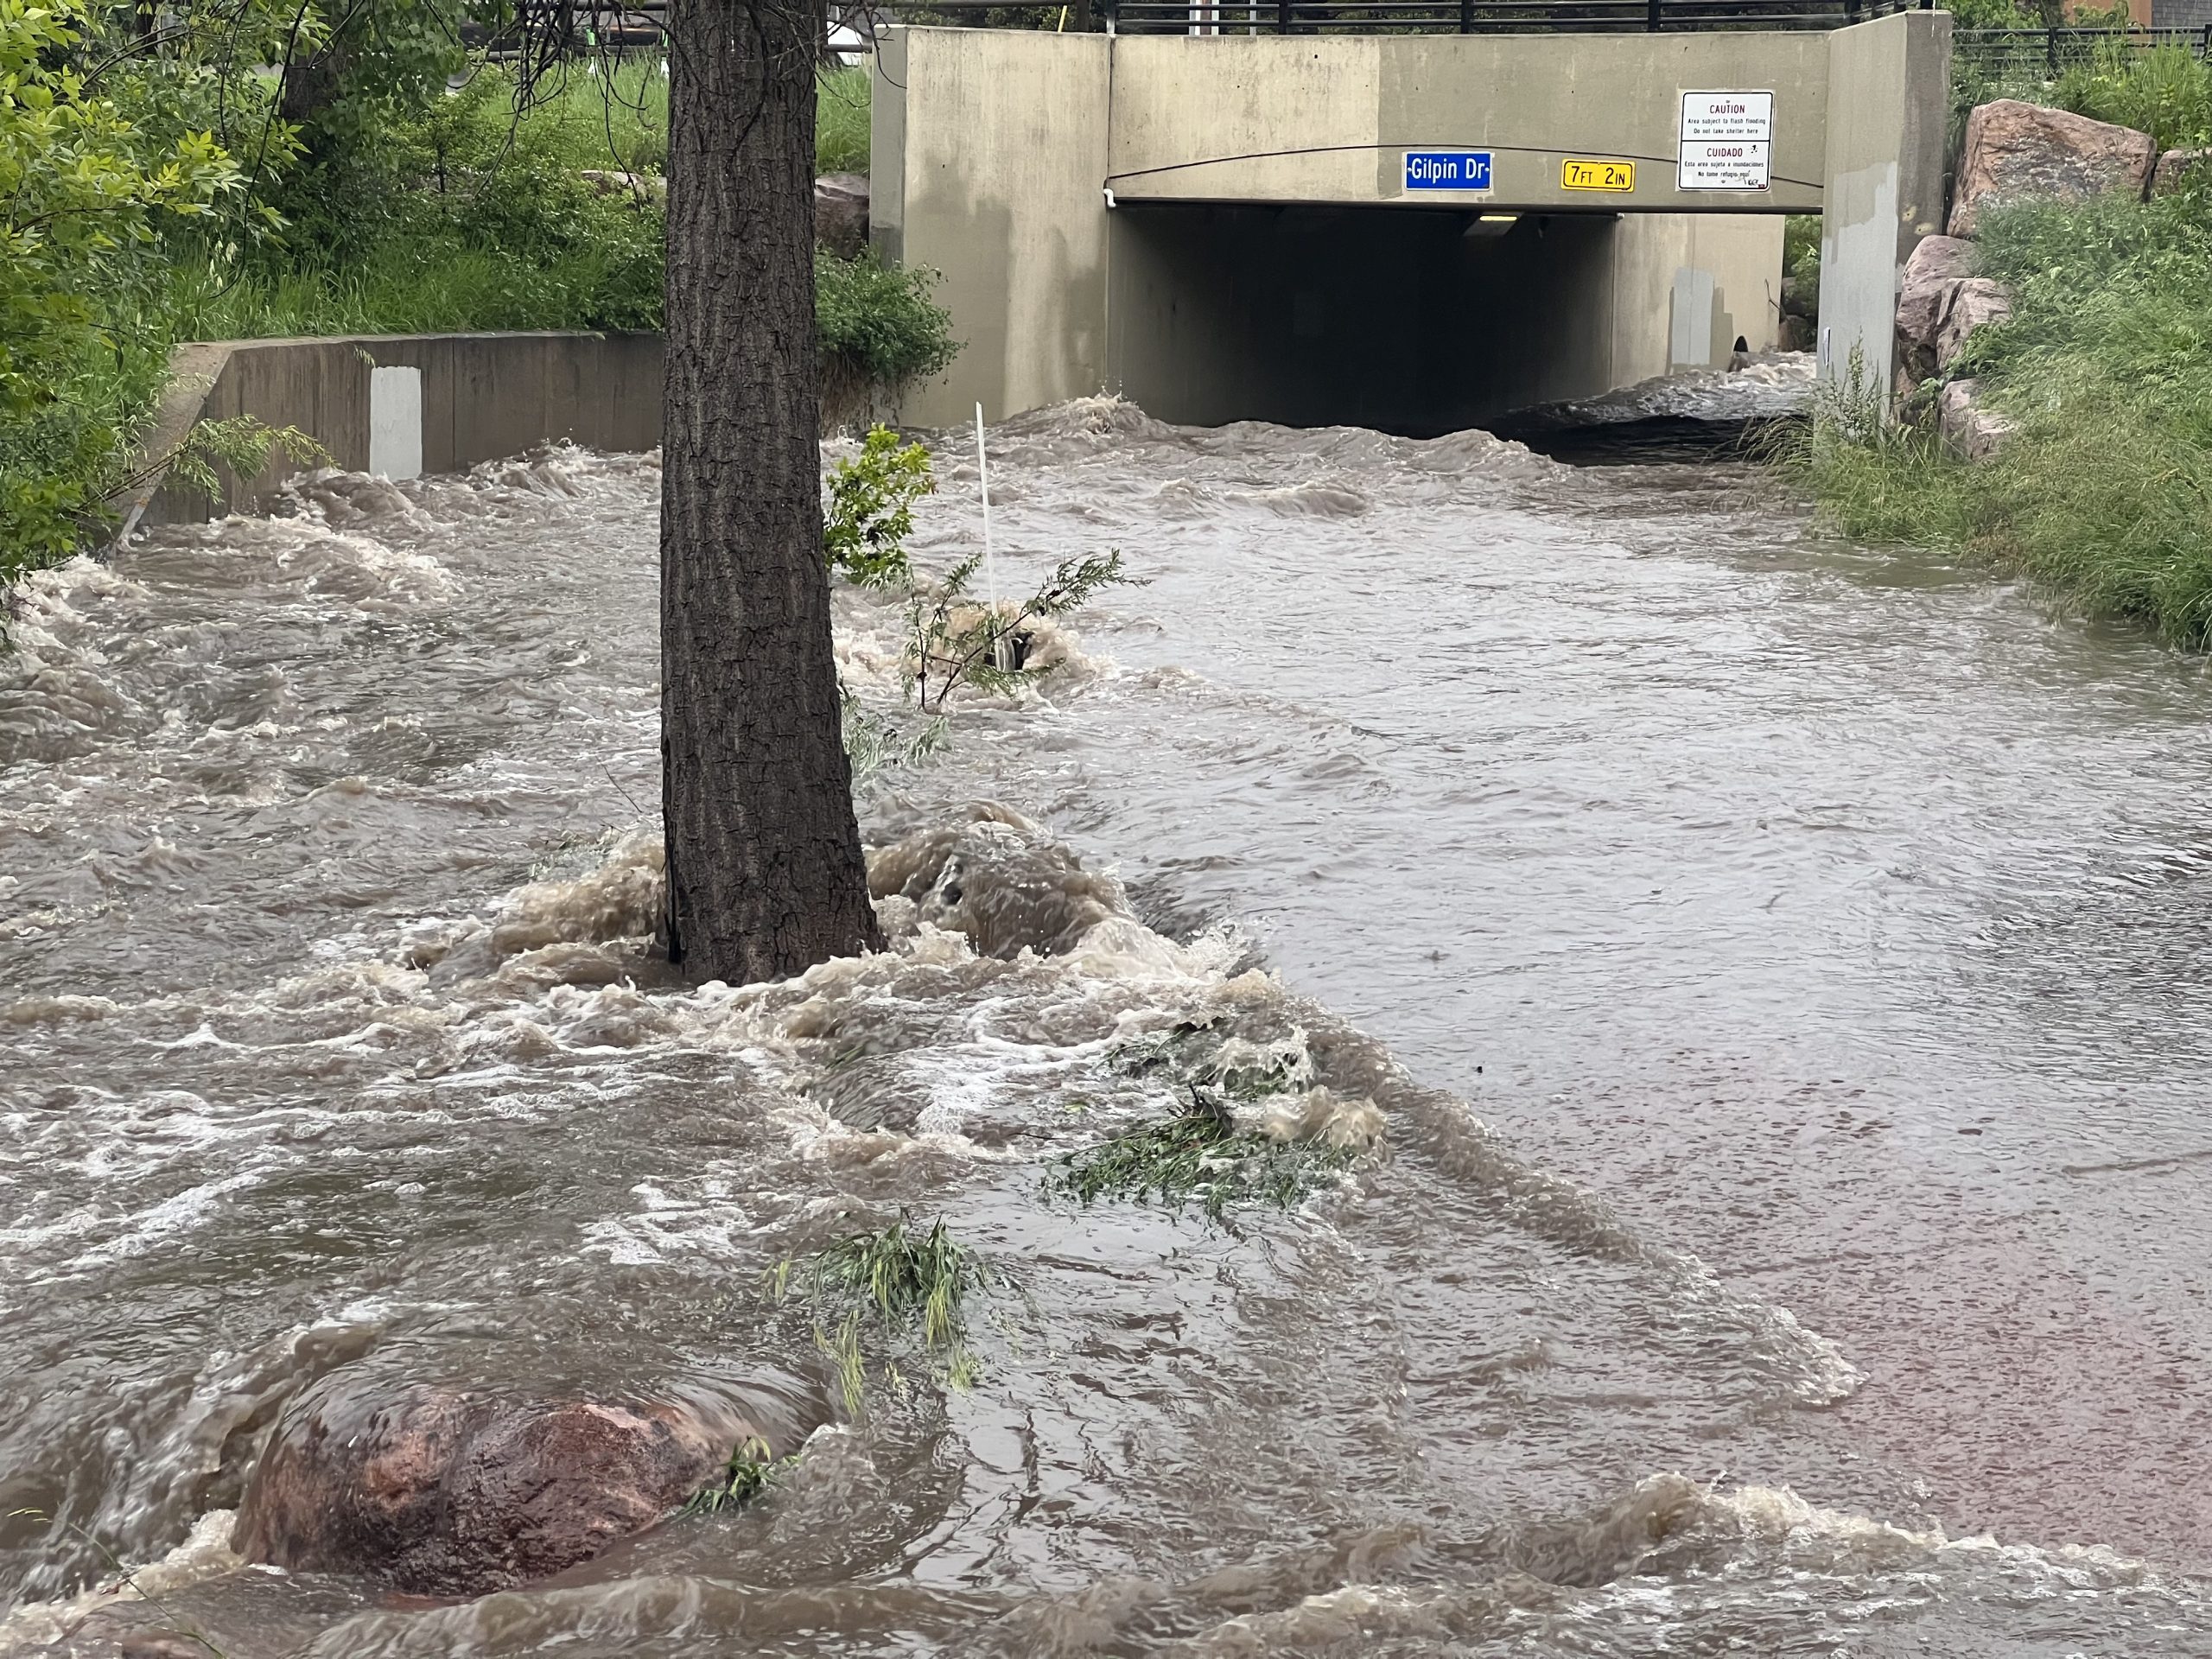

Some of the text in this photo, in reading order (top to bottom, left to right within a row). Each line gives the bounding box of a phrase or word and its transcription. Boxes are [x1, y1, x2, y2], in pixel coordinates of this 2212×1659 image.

[1710, 105, 1745, 113] CAUTION
[1707, 148, 1743, 156] CUIDADO
[1411, 158, 1485, 183] Gilpin Dr
